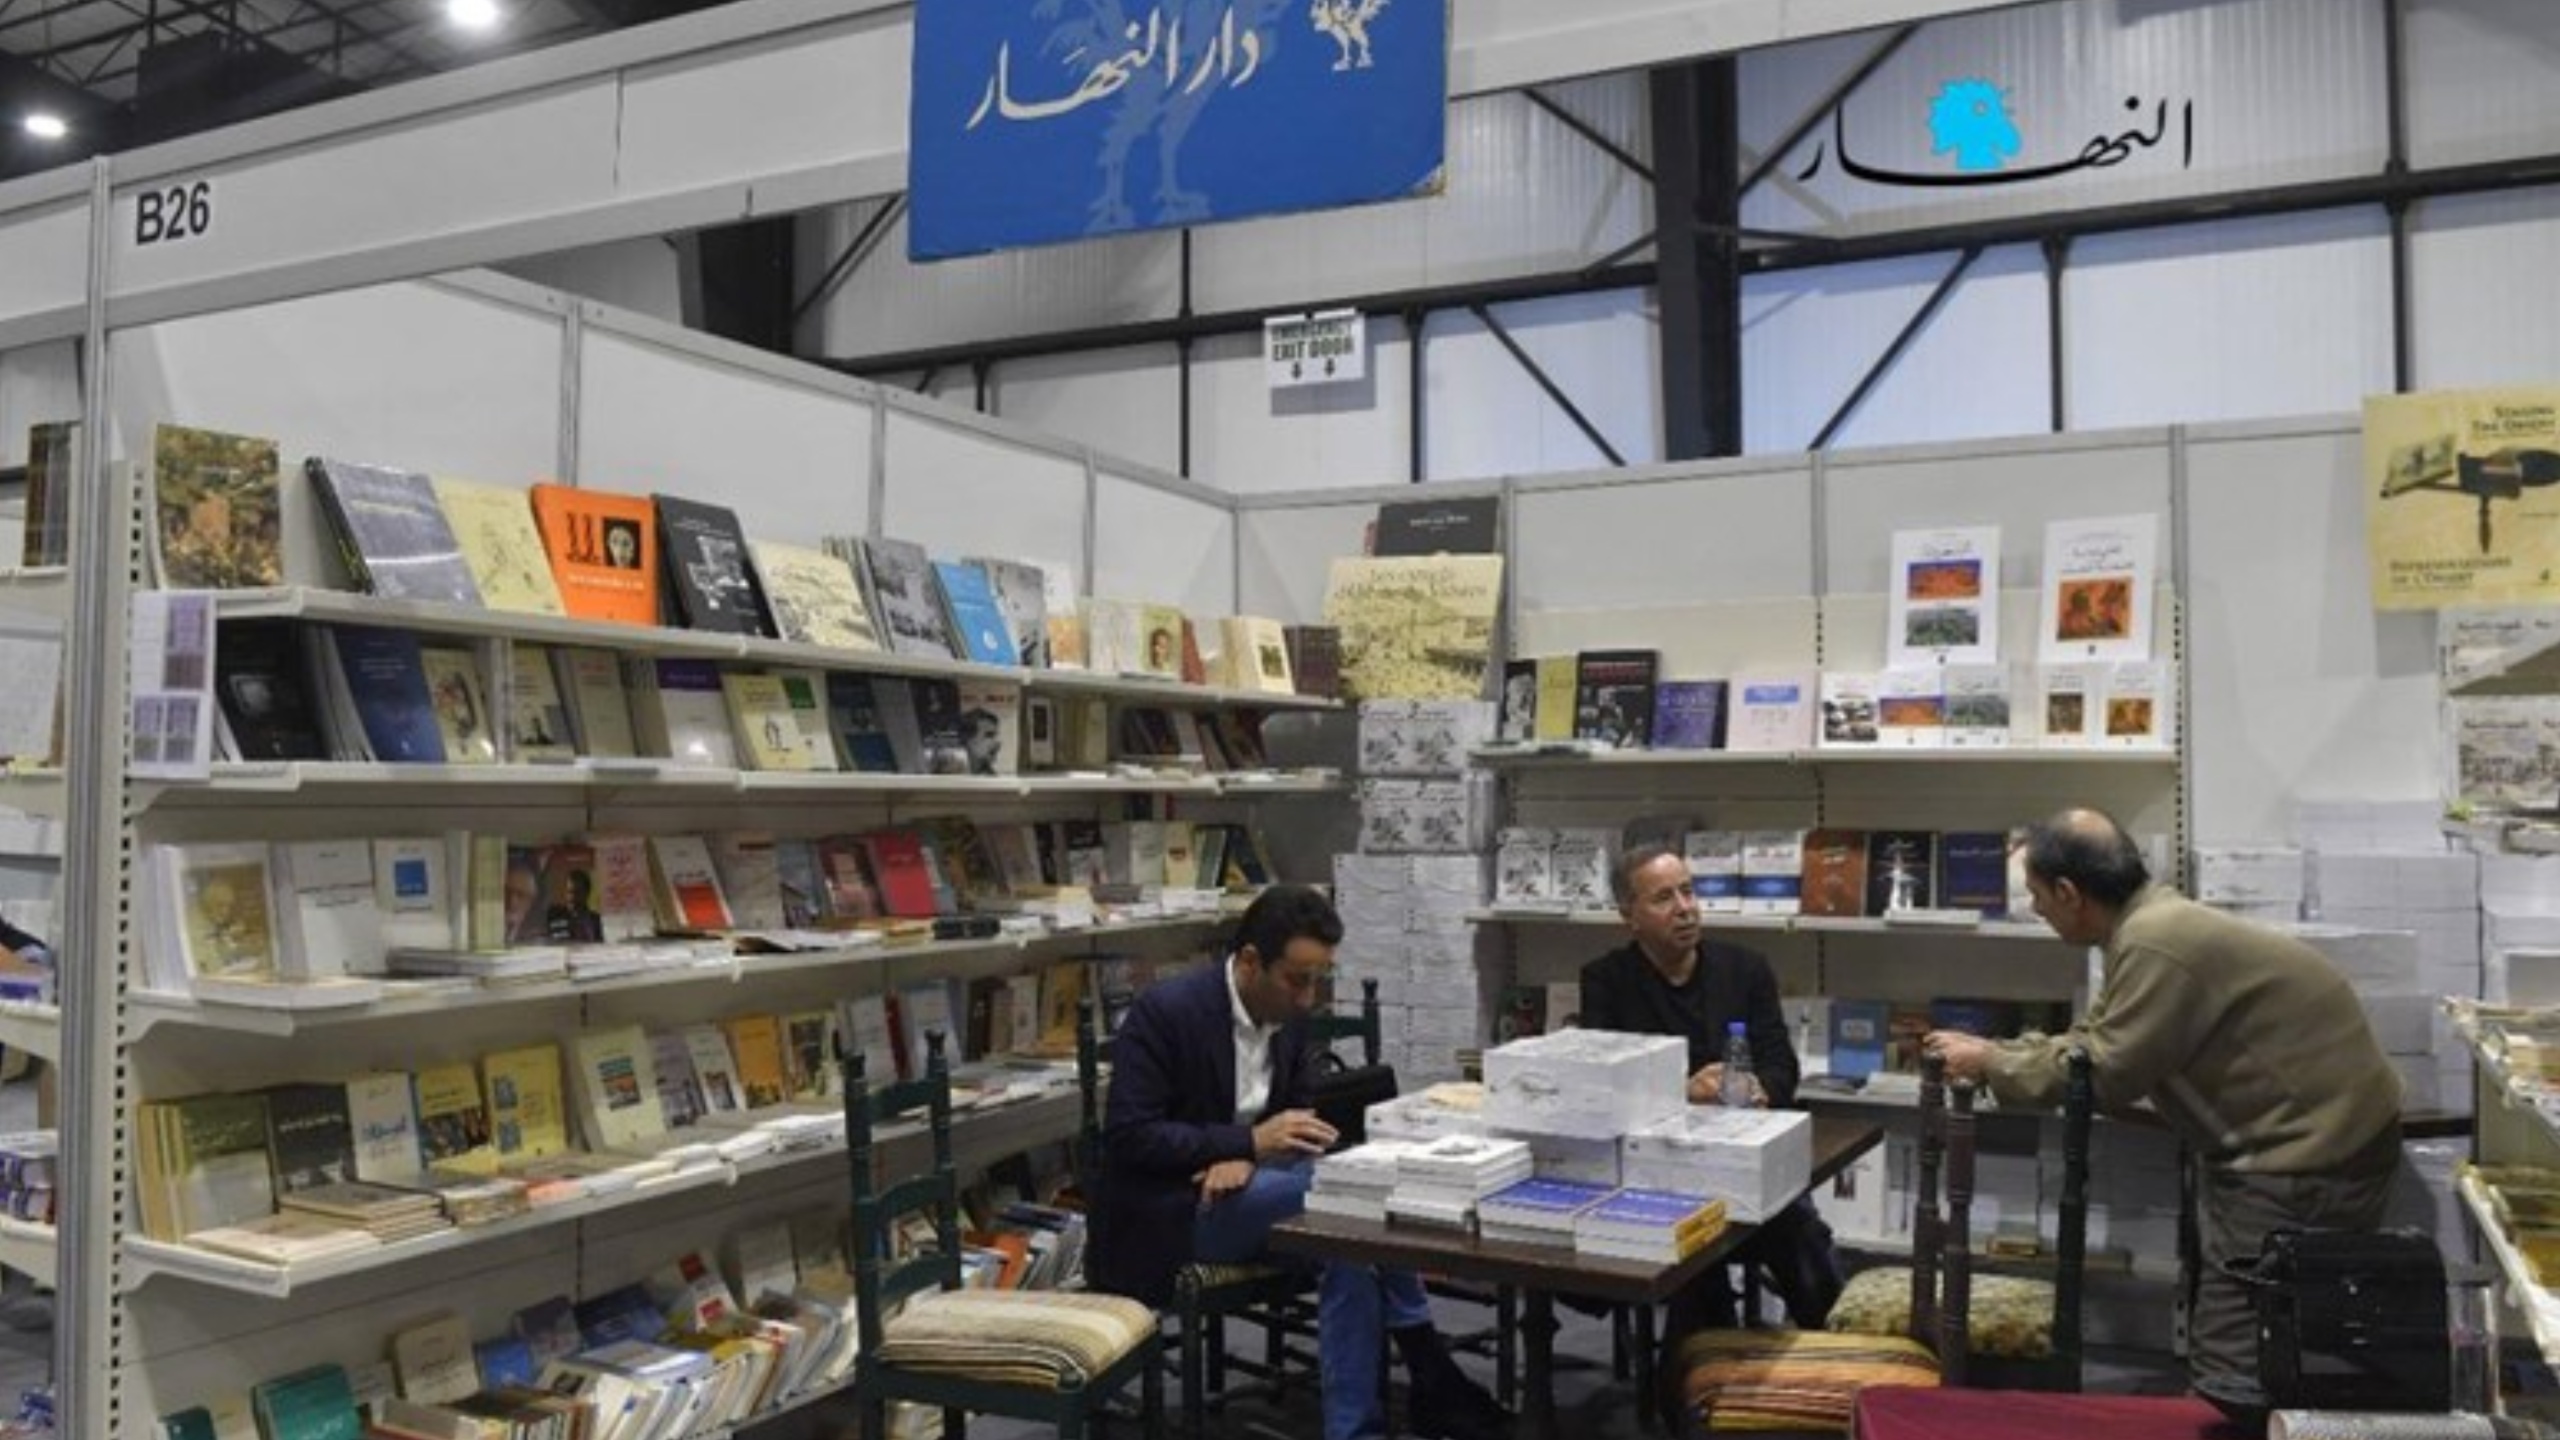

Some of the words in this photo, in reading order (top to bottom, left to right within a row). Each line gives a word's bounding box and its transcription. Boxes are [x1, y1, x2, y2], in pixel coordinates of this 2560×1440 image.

[1184, 5, 1260, 94] دار
[136, 181, 210, 245] B26
[1273, 341, 1306, 361] EXIT
[1309, 337, 1354, 358] DOOR
